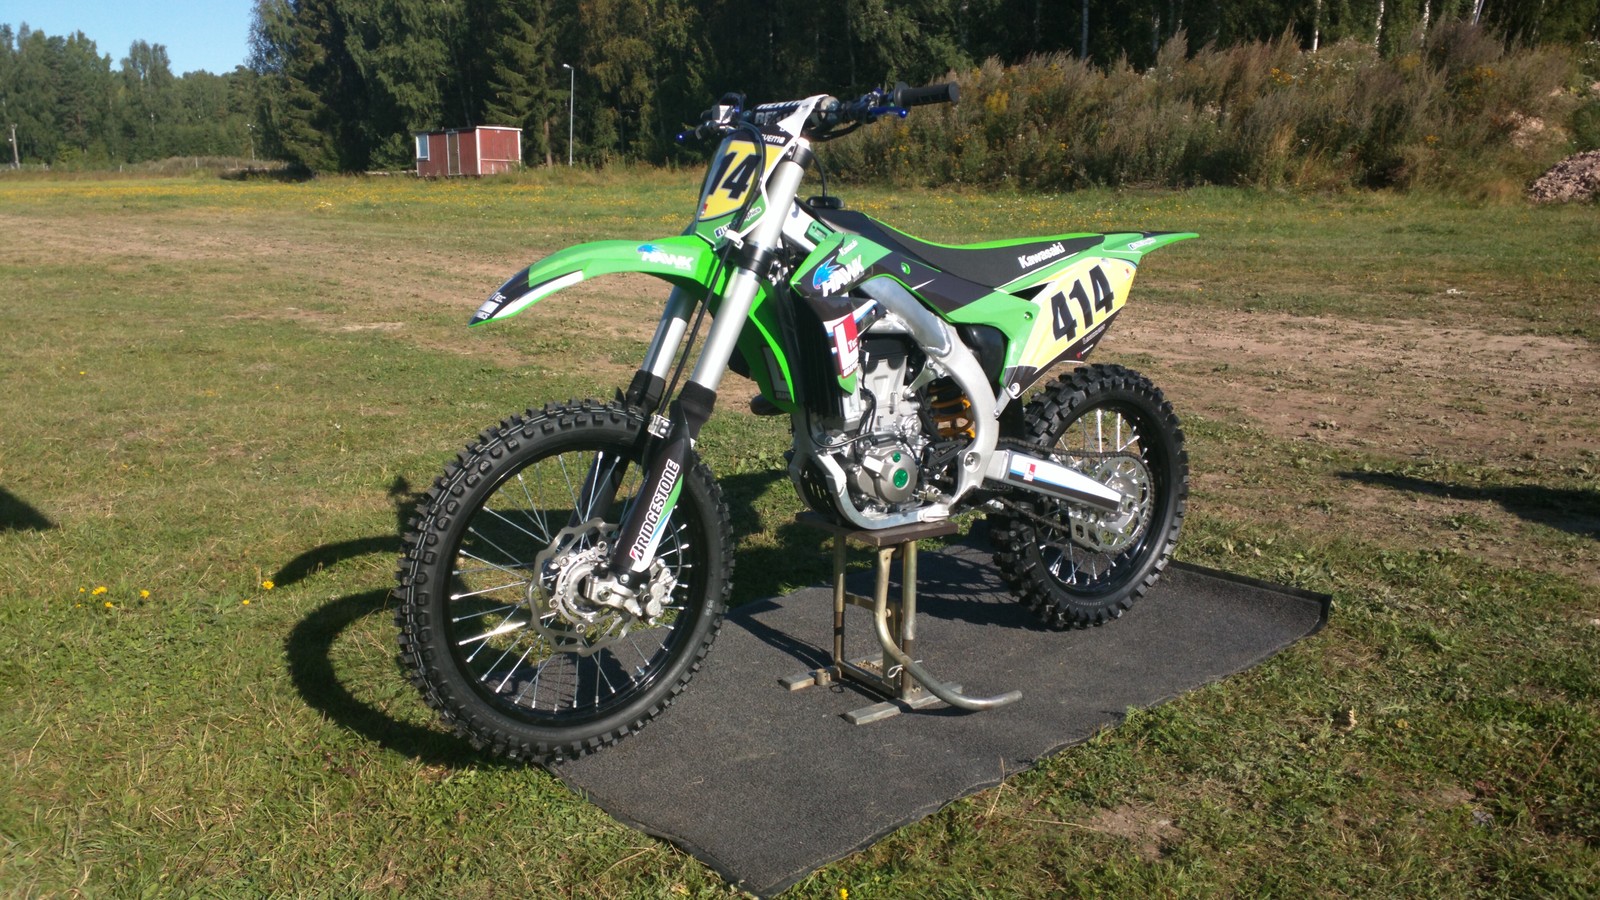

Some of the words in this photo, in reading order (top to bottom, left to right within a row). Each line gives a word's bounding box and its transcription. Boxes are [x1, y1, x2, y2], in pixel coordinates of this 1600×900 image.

[822, 254, 865, 297] HAWK
[1018, 242, 1066, 269] Kawasaki
[1050, 264, 1115, 342] 414
[629, 459, 680, 562] BRIDGESTONE
